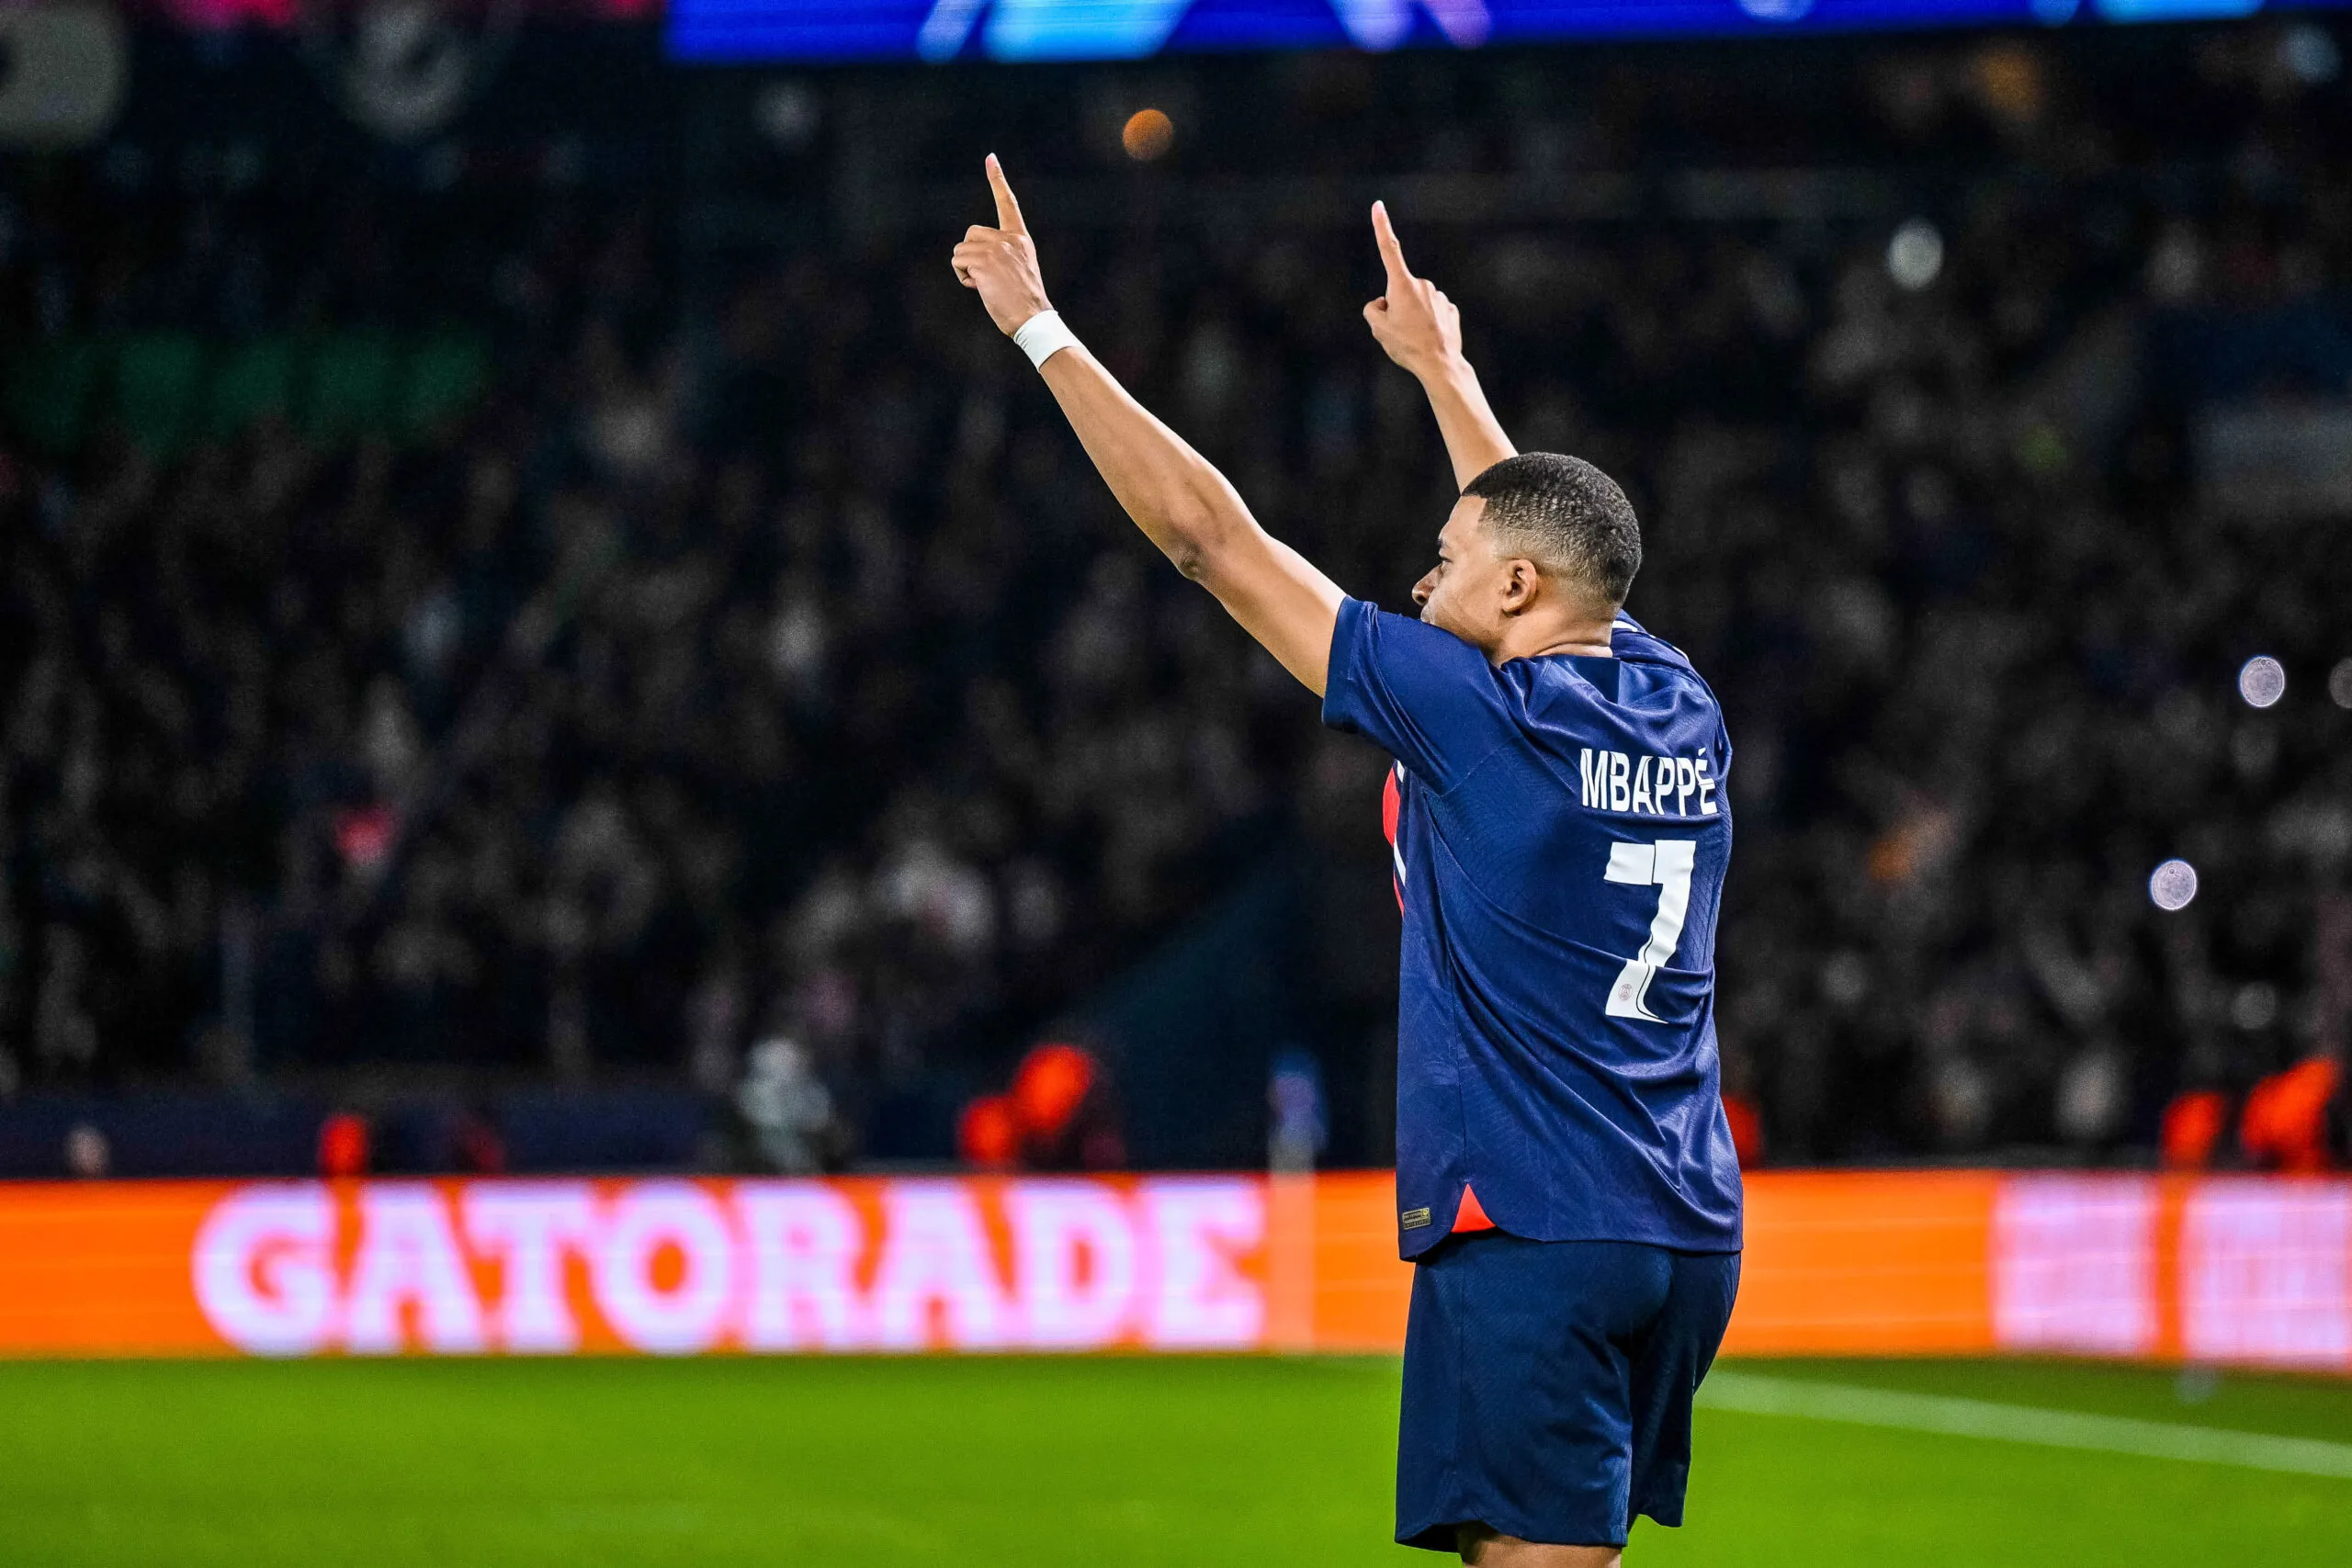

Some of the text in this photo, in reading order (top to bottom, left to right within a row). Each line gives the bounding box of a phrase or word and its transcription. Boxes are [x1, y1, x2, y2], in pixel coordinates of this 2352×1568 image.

[1580, 749, 1717, 816] MBAPPÉ
[1604, 840, 1696, 1023] 7
[194, 1179, 1264, 1356] GATORADE
